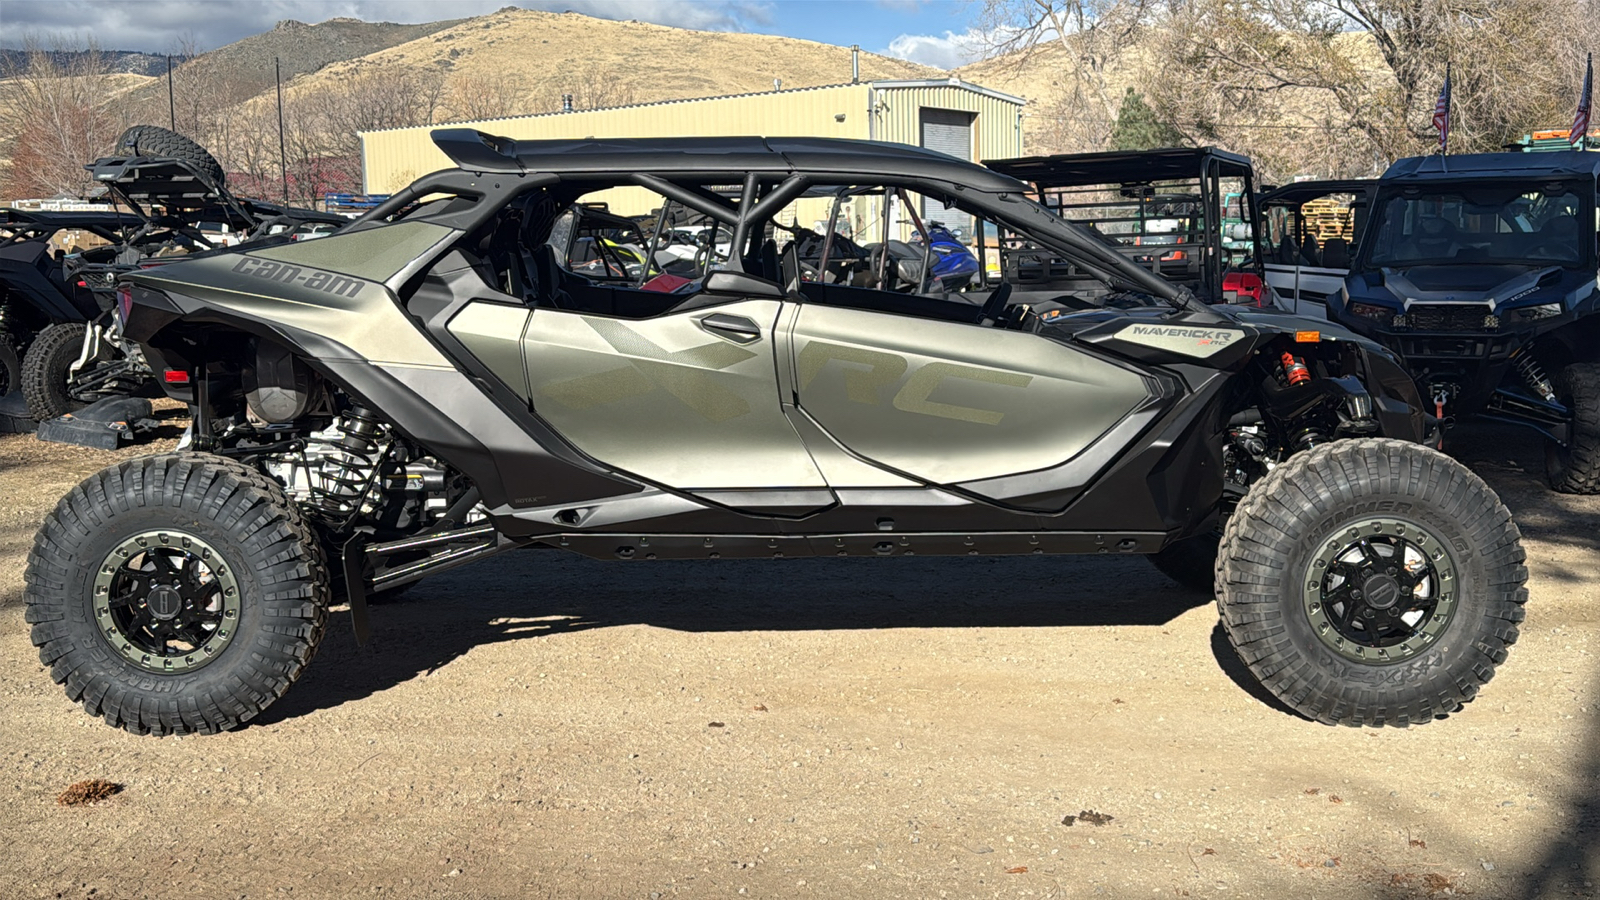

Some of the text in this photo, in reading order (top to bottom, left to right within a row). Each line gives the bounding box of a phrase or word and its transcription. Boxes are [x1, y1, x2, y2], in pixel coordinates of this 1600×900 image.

[231, 257, 366, 298] can-am
[1510, 286, 1541, 302] 1000
[1133, 326, 1232, 341] MAVERICK R
[514, 496, 539, 504] ROTAX
[1307, 500, 1414, 546] HAMMER
